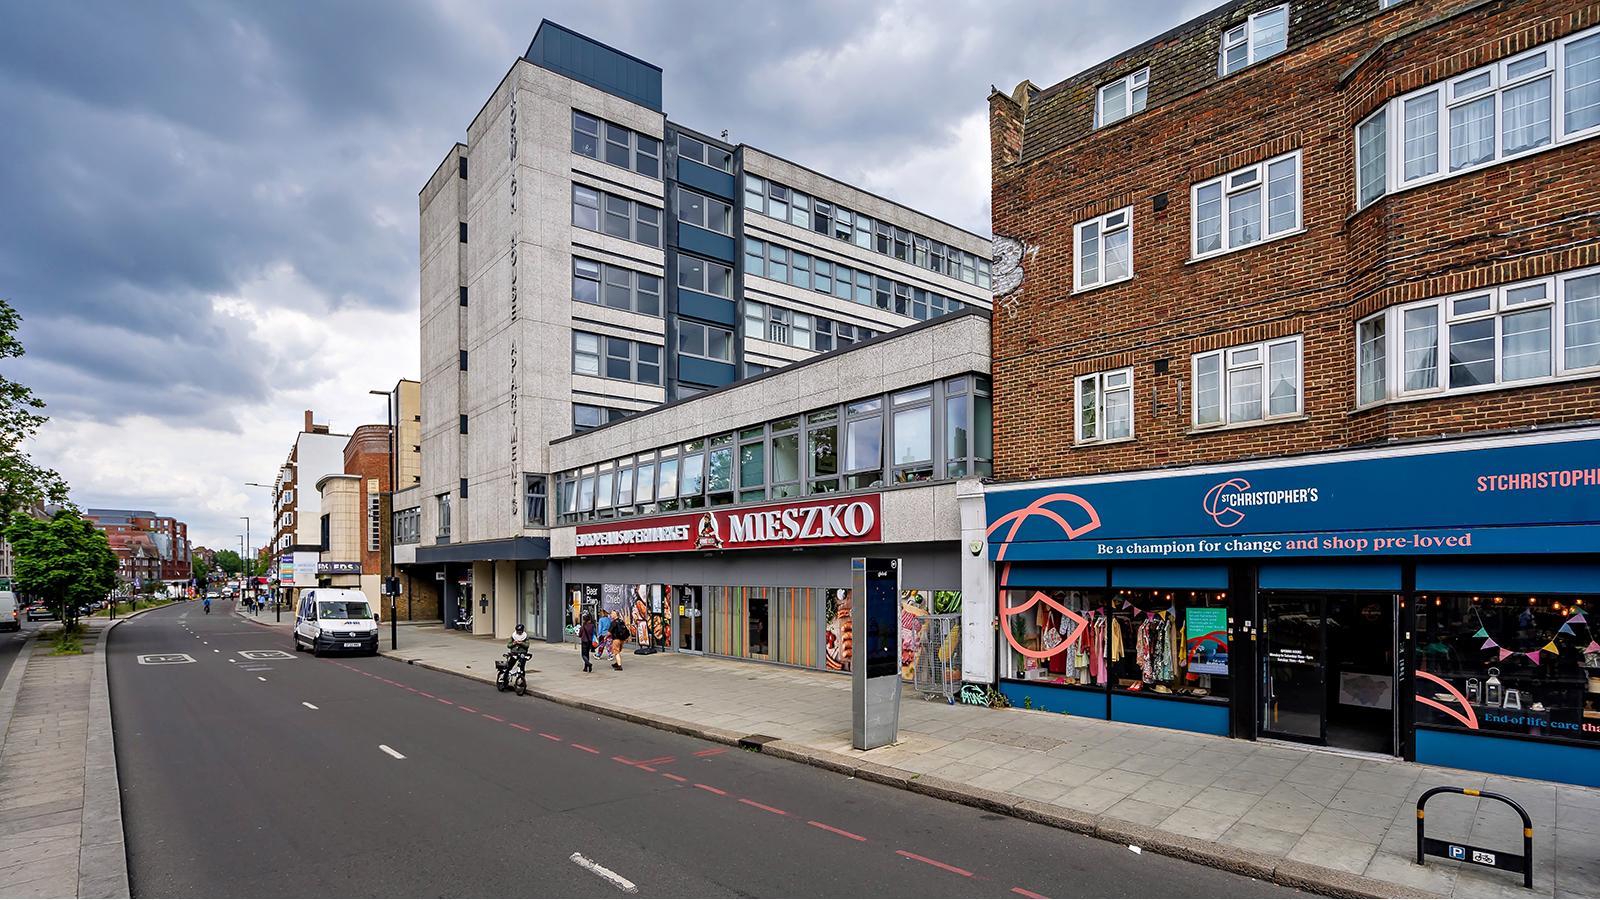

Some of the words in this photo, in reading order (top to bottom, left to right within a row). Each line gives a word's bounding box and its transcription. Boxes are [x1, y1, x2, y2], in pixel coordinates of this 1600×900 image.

[510, 231, 518, 322] HOUSE
[1477, 468, 1600, 492] STCHRISTOPH
[728, 501, 874, 543] MIESZKO
[618, 524, 690, 545] SUPERMARKET
[1097, 544, 1115, 555] Be
[1116, 546, 1124, 555] a
[1126, 541, 1195, 556] champion
[1198, 540, 1221, 552] for
[1223, 538, 1282, 554] change
[1285, 536, 1319, 550] and
[1323, 535, 1369, 551] shop
[1373, 532, 1473, 551] pre-loved
[1485, 713, 1526, 725] End-of
[1526, 716, 1548, 727] life
[1550, 720, 1579, 731] care
[1453, 847, 1463, 857] P
